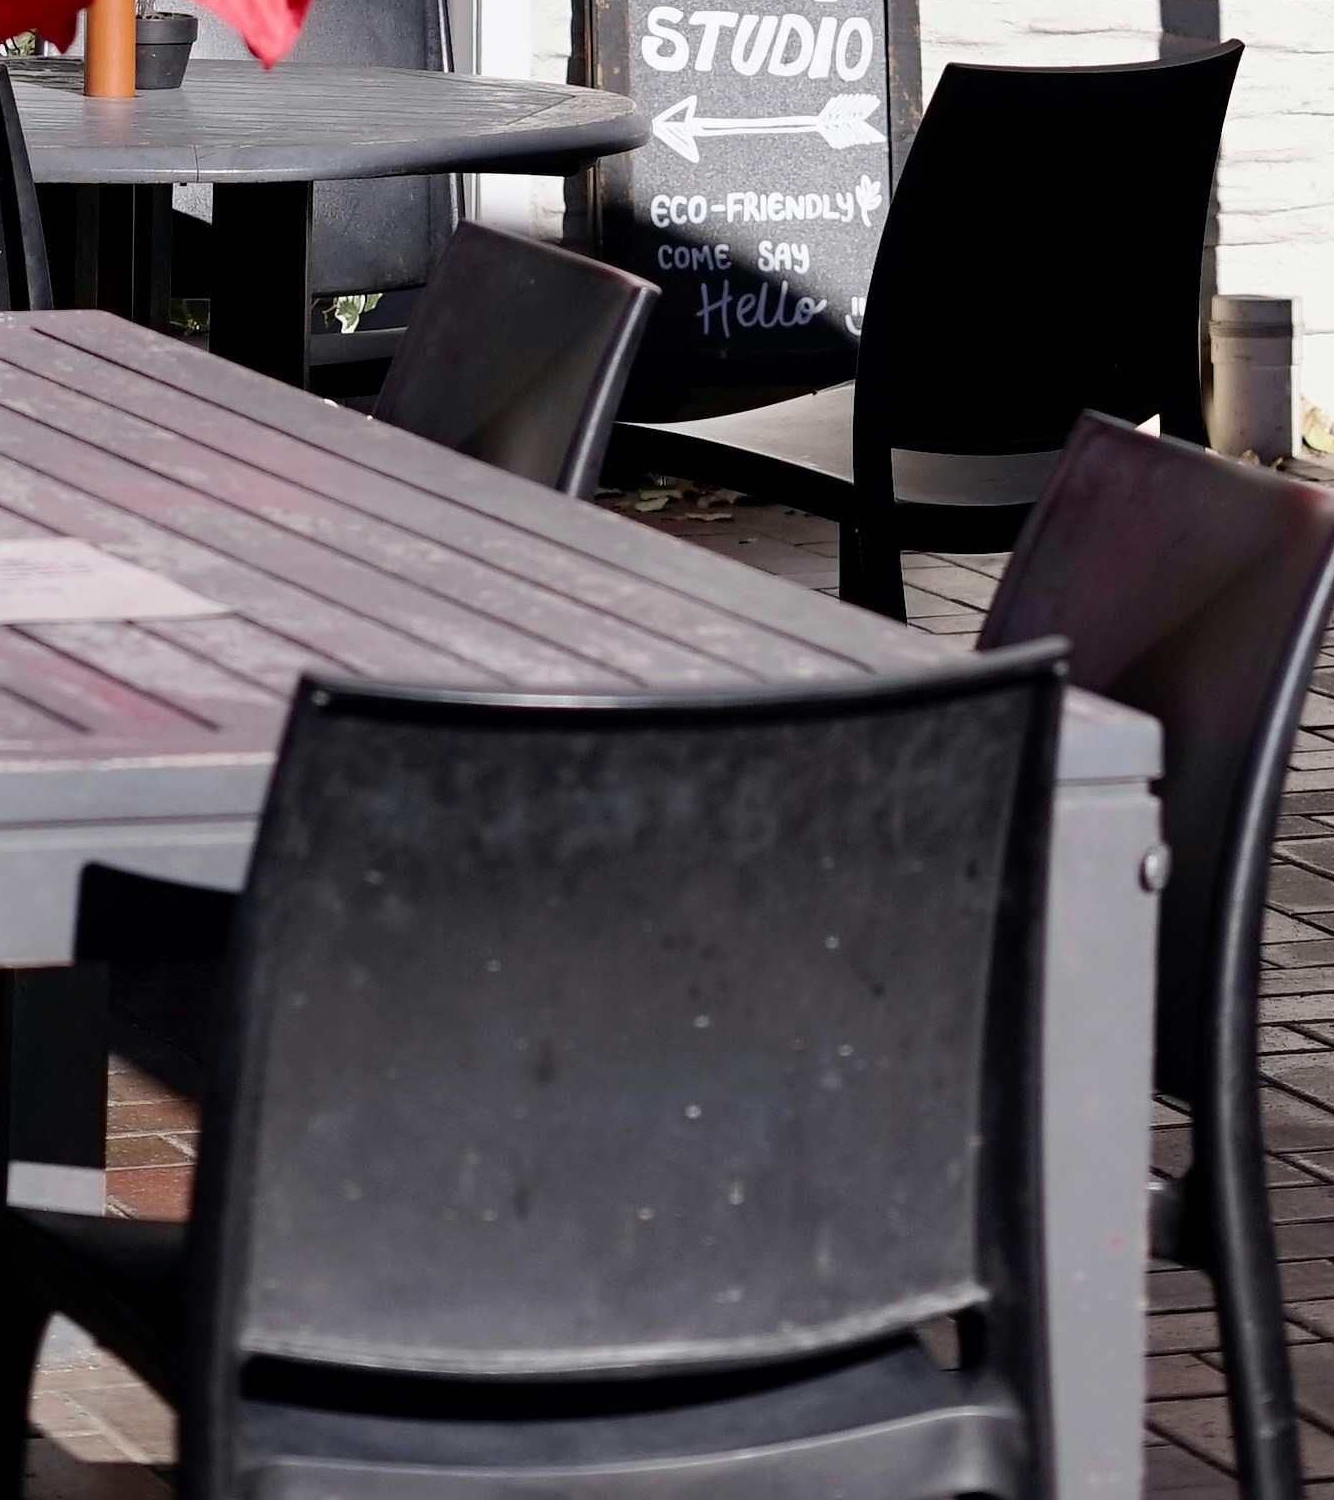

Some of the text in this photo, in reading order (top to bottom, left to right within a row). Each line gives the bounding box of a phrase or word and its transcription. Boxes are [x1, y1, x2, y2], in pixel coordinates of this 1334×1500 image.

[641, 6, 874, 82] STUDIO
[651, 192, 855, 227] ECO-FRIENDLY
[658, 240, 810, 274] COME SAY
[697, 282, 828, 339] Hello
